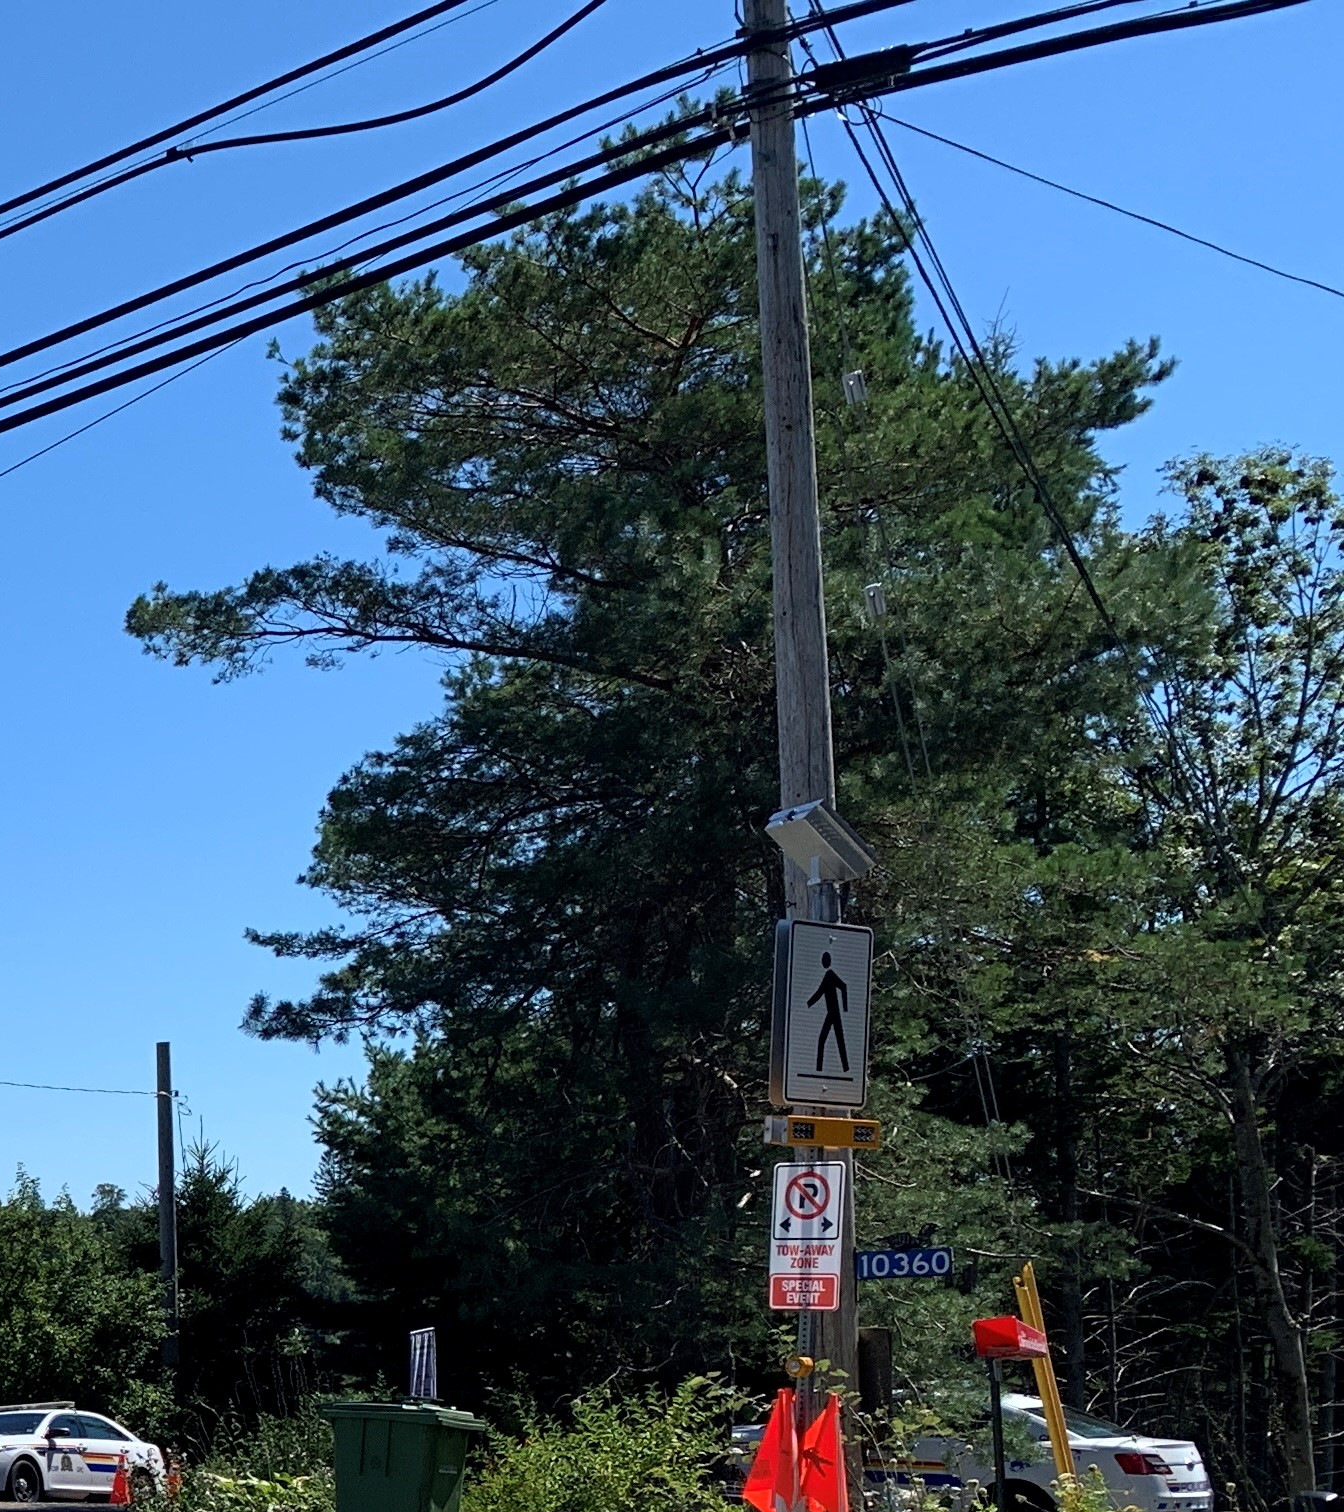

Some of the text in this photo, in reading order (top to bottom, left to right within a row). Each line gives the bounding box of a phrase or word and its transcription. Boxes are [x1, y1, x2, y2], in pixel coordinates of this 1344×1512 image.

[776, 1244, 835, 1256] TOW-AWAY
[790, 1257, 819, 1269] ZONE
[861, 1250, 950, 1278] 10360
[781, 1279, 826, 1292] SPECIAL
[786, 1292, 821, 1305] EVENT
